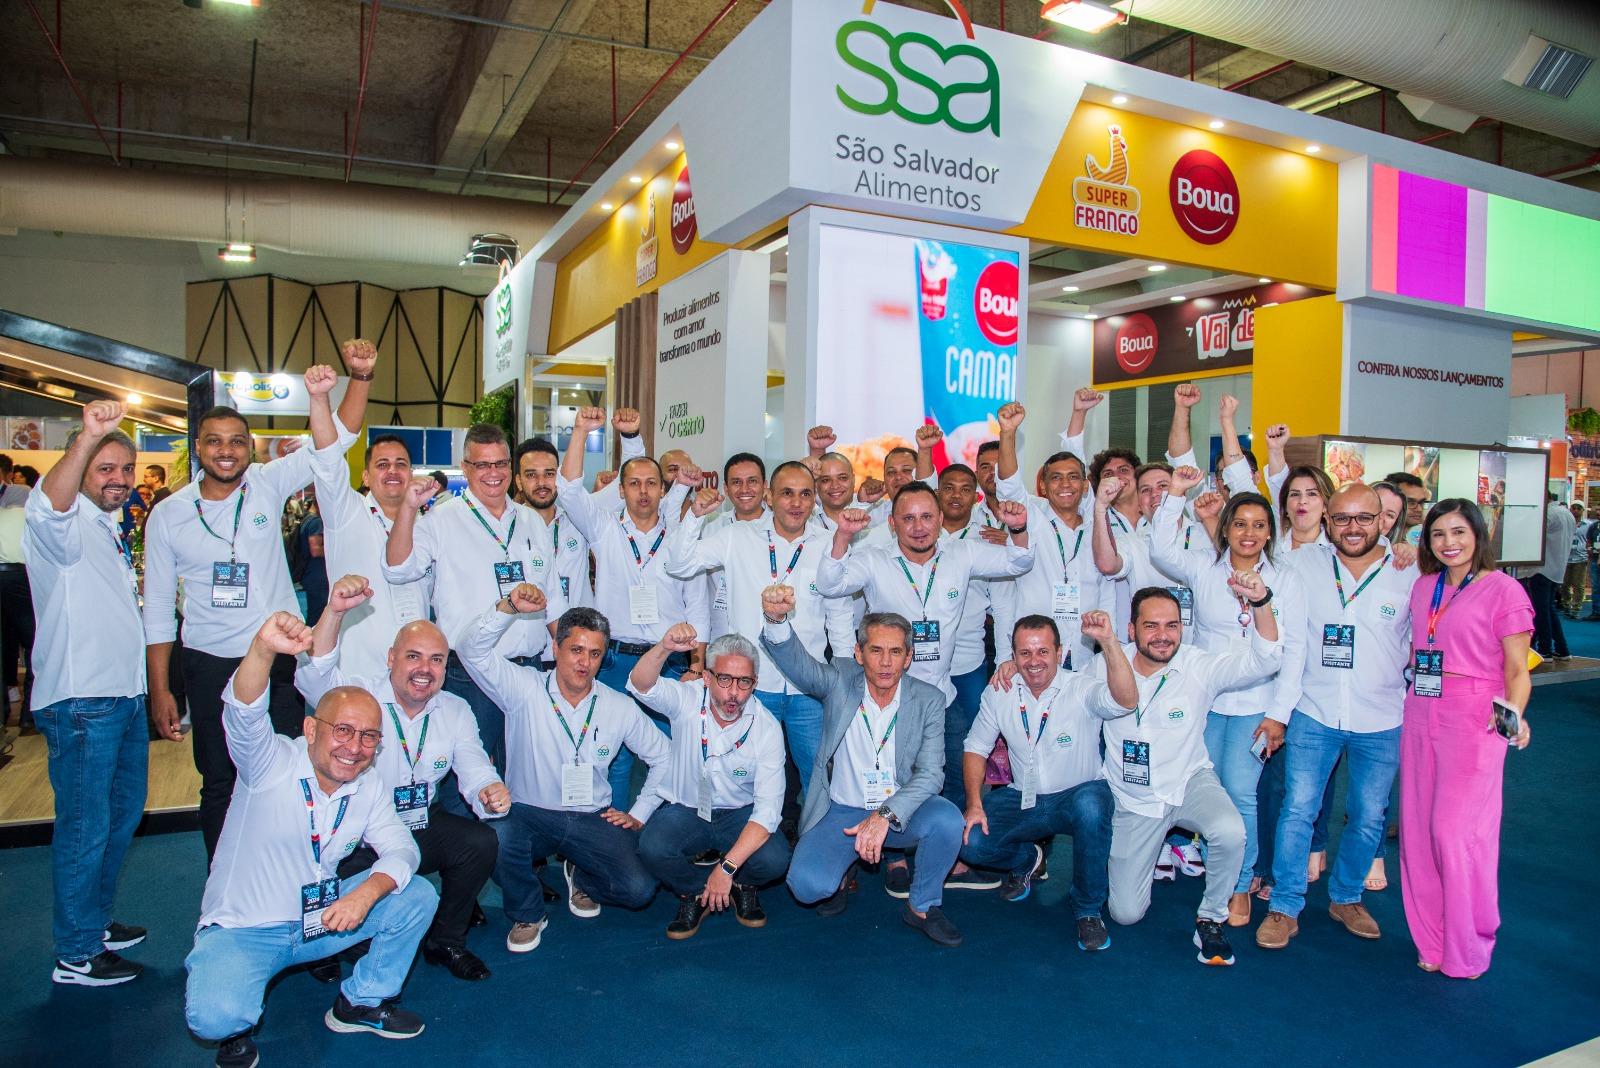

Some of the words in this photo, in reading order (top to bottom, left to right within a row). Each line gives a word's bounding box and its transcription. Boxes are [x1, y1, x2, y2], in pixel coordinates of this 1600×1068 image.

[836, 20, 1000, 138] ssa
[836, 134, 884, 164] São
[893, 143, 1000, 184] Salvador
[854, 169, 981, 212] Alimentos
[1087, 186, 1128, 208] SUPER
[1177, 177, 1234, 215] Boua
[1076, 205, 1138, 235] FRANGO
[663, 304, 687, 326] Produzir
[688, 291, 720, 315] alimentos
[980, 287, 1018, 317] Bou
[674, 326, 687, 339] com
[689, 317, 705, 334] amor
[1201, 314, 1230, 351] Vai
[660, 345, 690, 363] transforma
[691, 341, 696, 352] o
[697, 329, 721, 350] mundo
[1120, 335, 1153, 354] Boua
[1358, 361, 1400, 377] CONFIRA
[1403, 367, 1438, 381] NOSSOS
[1441, 370, 1504, 388] LANÇAMENTOS
[670, 402, 688, 419] FAZER
[669, 421, 675, 438] O
[677, 416, 705, 437] CERTO
[411, 823, 426, 831] ANTE
[305, 928, 326, 938] VISITA
